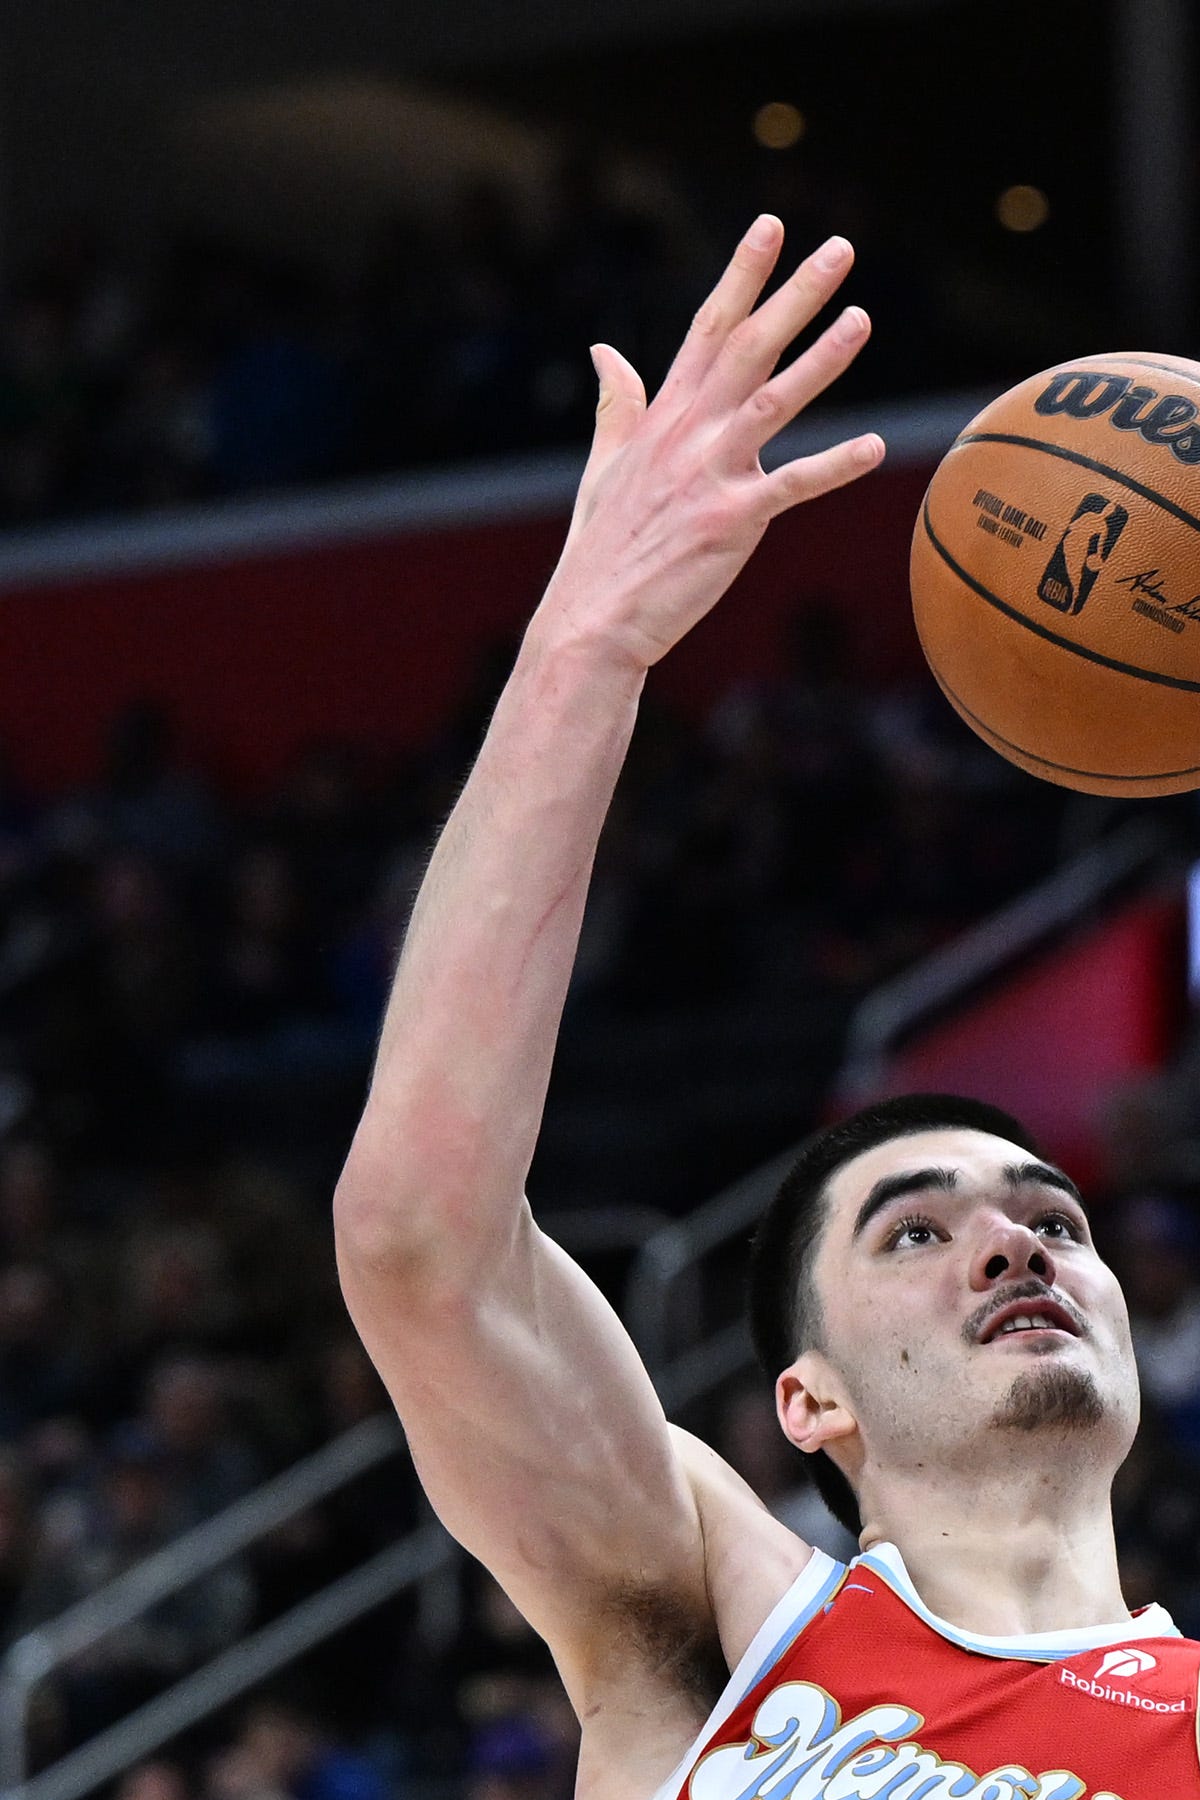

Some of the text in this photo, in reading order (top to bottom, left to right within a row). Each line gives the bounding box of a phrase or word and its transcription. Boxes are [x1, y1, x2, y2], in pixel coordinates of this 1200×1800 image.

[1023, 517, 1048, 541] BALL
[1042, 577, 1069, 604] NBA
[1060, 1668, 1185, 1713] Robinhood
